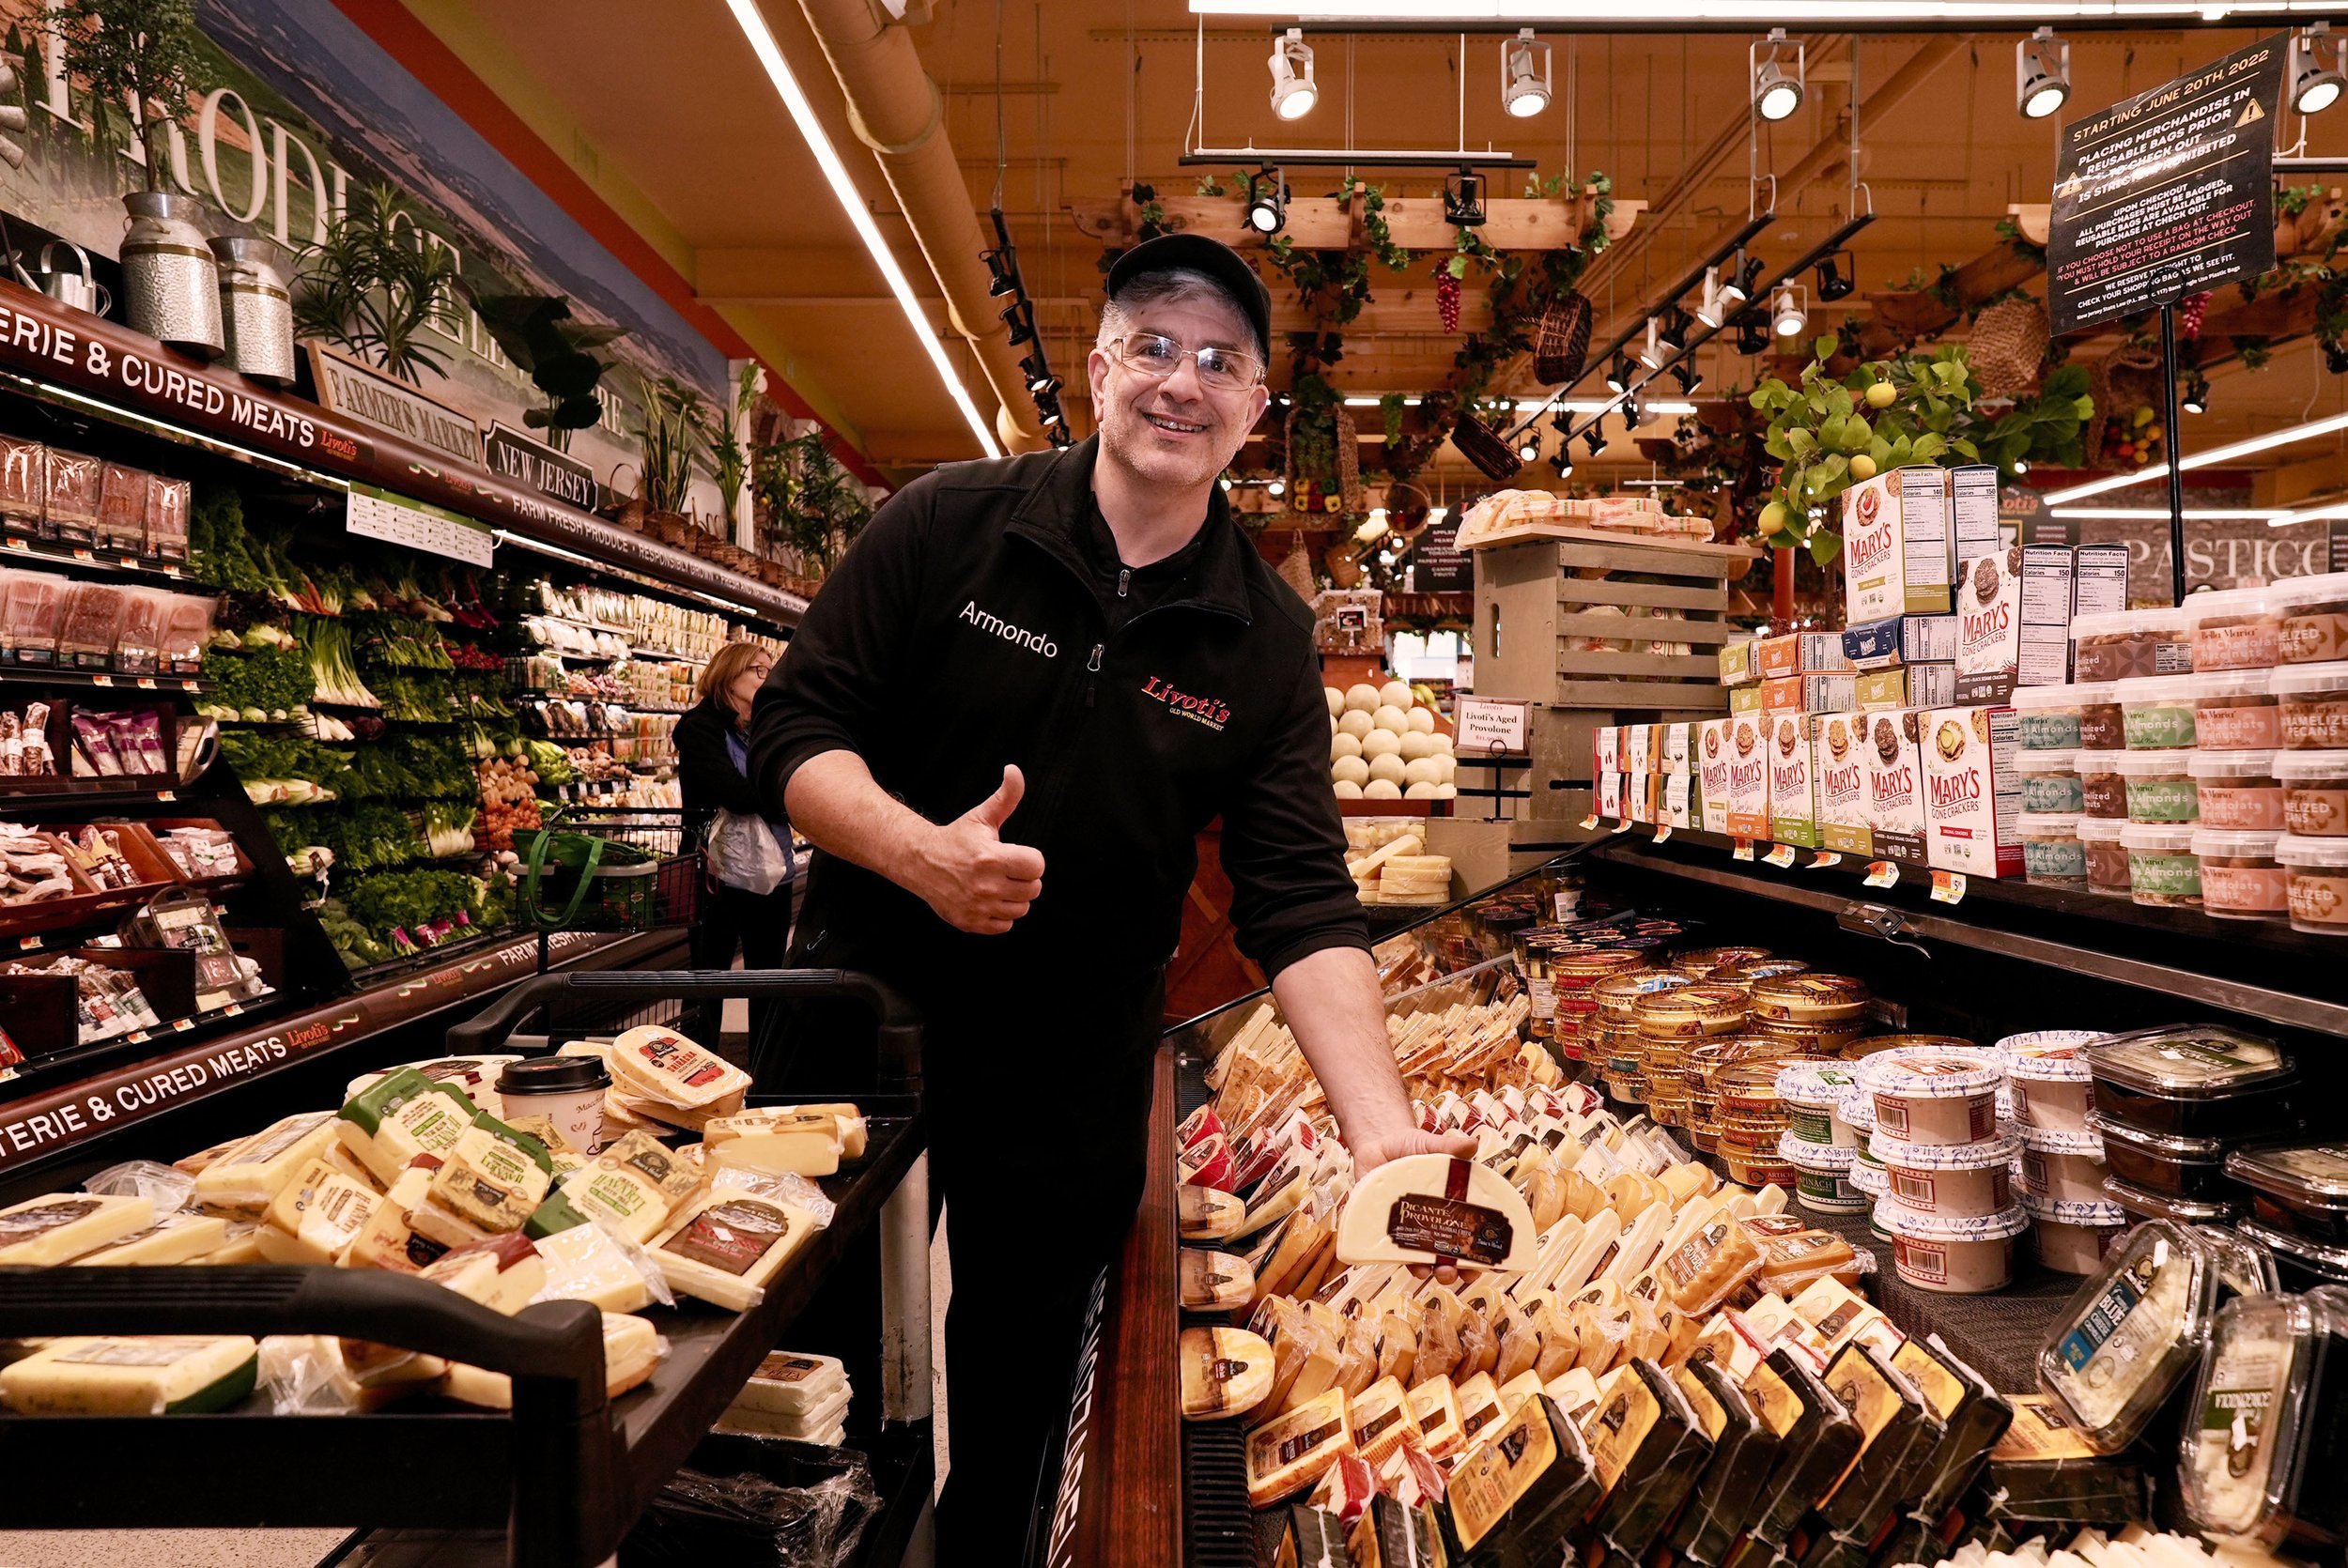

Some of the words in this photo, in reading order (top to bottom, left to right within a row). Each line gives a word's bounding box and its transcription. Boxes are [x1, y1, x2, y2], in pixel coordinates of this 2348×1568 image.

[2073, 105, 2141, 143] STARTING
[2145, 88, 2181, 112] JUNE
[2184, 70, 2225, 96] 20TH,
[2229, 49, 2270, 75] 2022
[2078, 137, 2133, 166] PLACING
[2136, 96, 2230, 142] MERCHANDISE
[2233, 87, 2251, 101] IN
[2087, 144, 2148, 175] REUSABLE
[2149, 129, 2186, 150] BAGS
[2187, 109, 2232, 134] PRIOR
[2127, 148, 2172, 172] CHECK
[2174, 133, 2201, 152] OUT
[2078, 192, 2092, 203] IS
[2078, 225, 2094, 238] ALL
[2094, 207, 2145, 233] PURCHASES
[2146, 196, 2171, 214] MUST
[2171, 193, 2185, 205] BE
[2185, 178, 2227, 200] BAGGED.
[2113, 202, 2139, 218] UPON
[2139, 183, 2188, 207] CHECKOUT
[2075, 228, 2117, 248] REUSABLE
[2117, 220, 2142, 235] BAGS
[2142, 211, 2160, 224] ARE
[2161, 192, 2212, 215] AVAILABLE
[2213, 184, 2233, 197] FOR
[2095, 229, 2141, 249] PURCHASE
[2141, 223, 2155, 233] AT
[2155, 210, 2186, 227] CHECK
[2187, 203, 2210, 215] OUT.
[2057, 265, 2065, 273] IF
[2065, 258, 2081, 270] YOU
[2082, 248, 2114, 266] CHOOSE
[2115, 241, 2134, 254] NOT
[2134, 238, 2146, 247] TO
[2147, 232, 2164, 242] USE
[2164, 229, 2170, 238] A
[2171, 222, 2191, 235] BAG
[2193, 216, 2204, 226] AT
[2059, 270, 2076, 283] YOU
[2076, 265, 2096, 279] MUST
[2097, 255, 2119, 270] HOLD
[2120, 249, 2143, 266] YOUR
[2143, 236, 2177, 254] RECEIPT
[2178, 232, 2191, 241] ON
[2193, 223, 2209, 235] THE
[2211, 217, 2232, 230] WAY
[2232, 209, 2253, 223] OUT
[2074, 277, 2080, 285] &
[2081, 270, 2099, 284] WILL
[2100, 267, 2110, 278] BE
[2111, 254, 2147, 273] SUBJECT
[2149, 250, 2161, 260] TO
[2162, 247, 2169, 256] A
[2170, 237, 2206, 254] RANDOM
[2207, 224, 2237, 241] CHECK
[2078, 295, 2101, 309] CHECK
[2102, 288, 2123, 303] YOUR
[2161, 271, 2180, 283] BAG
[2192, 263, 2205, 272] WE
[2206, 258, 2220, 269] SEE
[2221, 253, 2236, 264] FIT.
[2105, 281, 2117, 291] WE
[2116, 270, 2149, 288] RESERVE
[2189, 254, 2202, 265] TO
[2208, 269, 2228, 280] Plastic
[2227, 265, 2241, 274] Bags
[86, 341, 112, 377] &
[121, 354, 225, 415] CURED
[231, 394, 315, 448] MEATS
[326, 367, 419, 439] FARMER'S
[418, 407, 481, 465] MARKET
[496, 440, 535, 484] NEW
[536, 458, 592, 508] JERSEY
[512, 494, 546, 524] FARM
[547, 508, 583, 537] FRESH
[583, 519, 629, 554] PRODUCE
[1850, 522, 1892, 566] MARY'S
[959, 600, 1058, 657] Armondo
[1962, 600, 2010, 643] MARY'S
[1976, 632, 2007, 653] CRACKERS
[1141, 676, 1230, 724] Livoti's
[1466, 712, 1494, 722] Livoti's
[1495, 715, 1517, 724] Aged
[1168, 706, 1182, 716] OLD
[1181, 709, 1202, 723] WORLD
[1199, 715, 1225, 732] MARKET
[1470, 723, 1512, 734] Provolone
[2031, 725, 2078, 734] Almonds
[2289, 725, 2338, 737] PECANS
[1703, 761, 1727, 788] MARY'S
[1730, 758, 1762, 788] MARY'S
[1774, 759, 1805, 791] MARY'S
[1824, 761, 1861, 795] MARY'S
[1870, 763, 1913, 799] MARY'S
[1929, 766, 1981, 806] MARY'S
[1886, 794, 1913, 811] CRACKERS
[1931, 807, 1947, 820] GONE
[1947, 800, 1980, 818] CRACKERS
[2030, 789, 2073, 797] Almonds
[2036, 851, 2082, 861] Almonds
[496, 941, 536, 966] FARM
[87, 1096, 115, 1127] &
[116, 1061, 208, 1114] CURED
[206, 1036, 287, 1086] MEATS
[1400, 1201, 1451, 1218] PICANTE
[1400, 1209, 1469, 1230] PROVOLONE
[2099, 1294, 2125, 1326] BLUE
